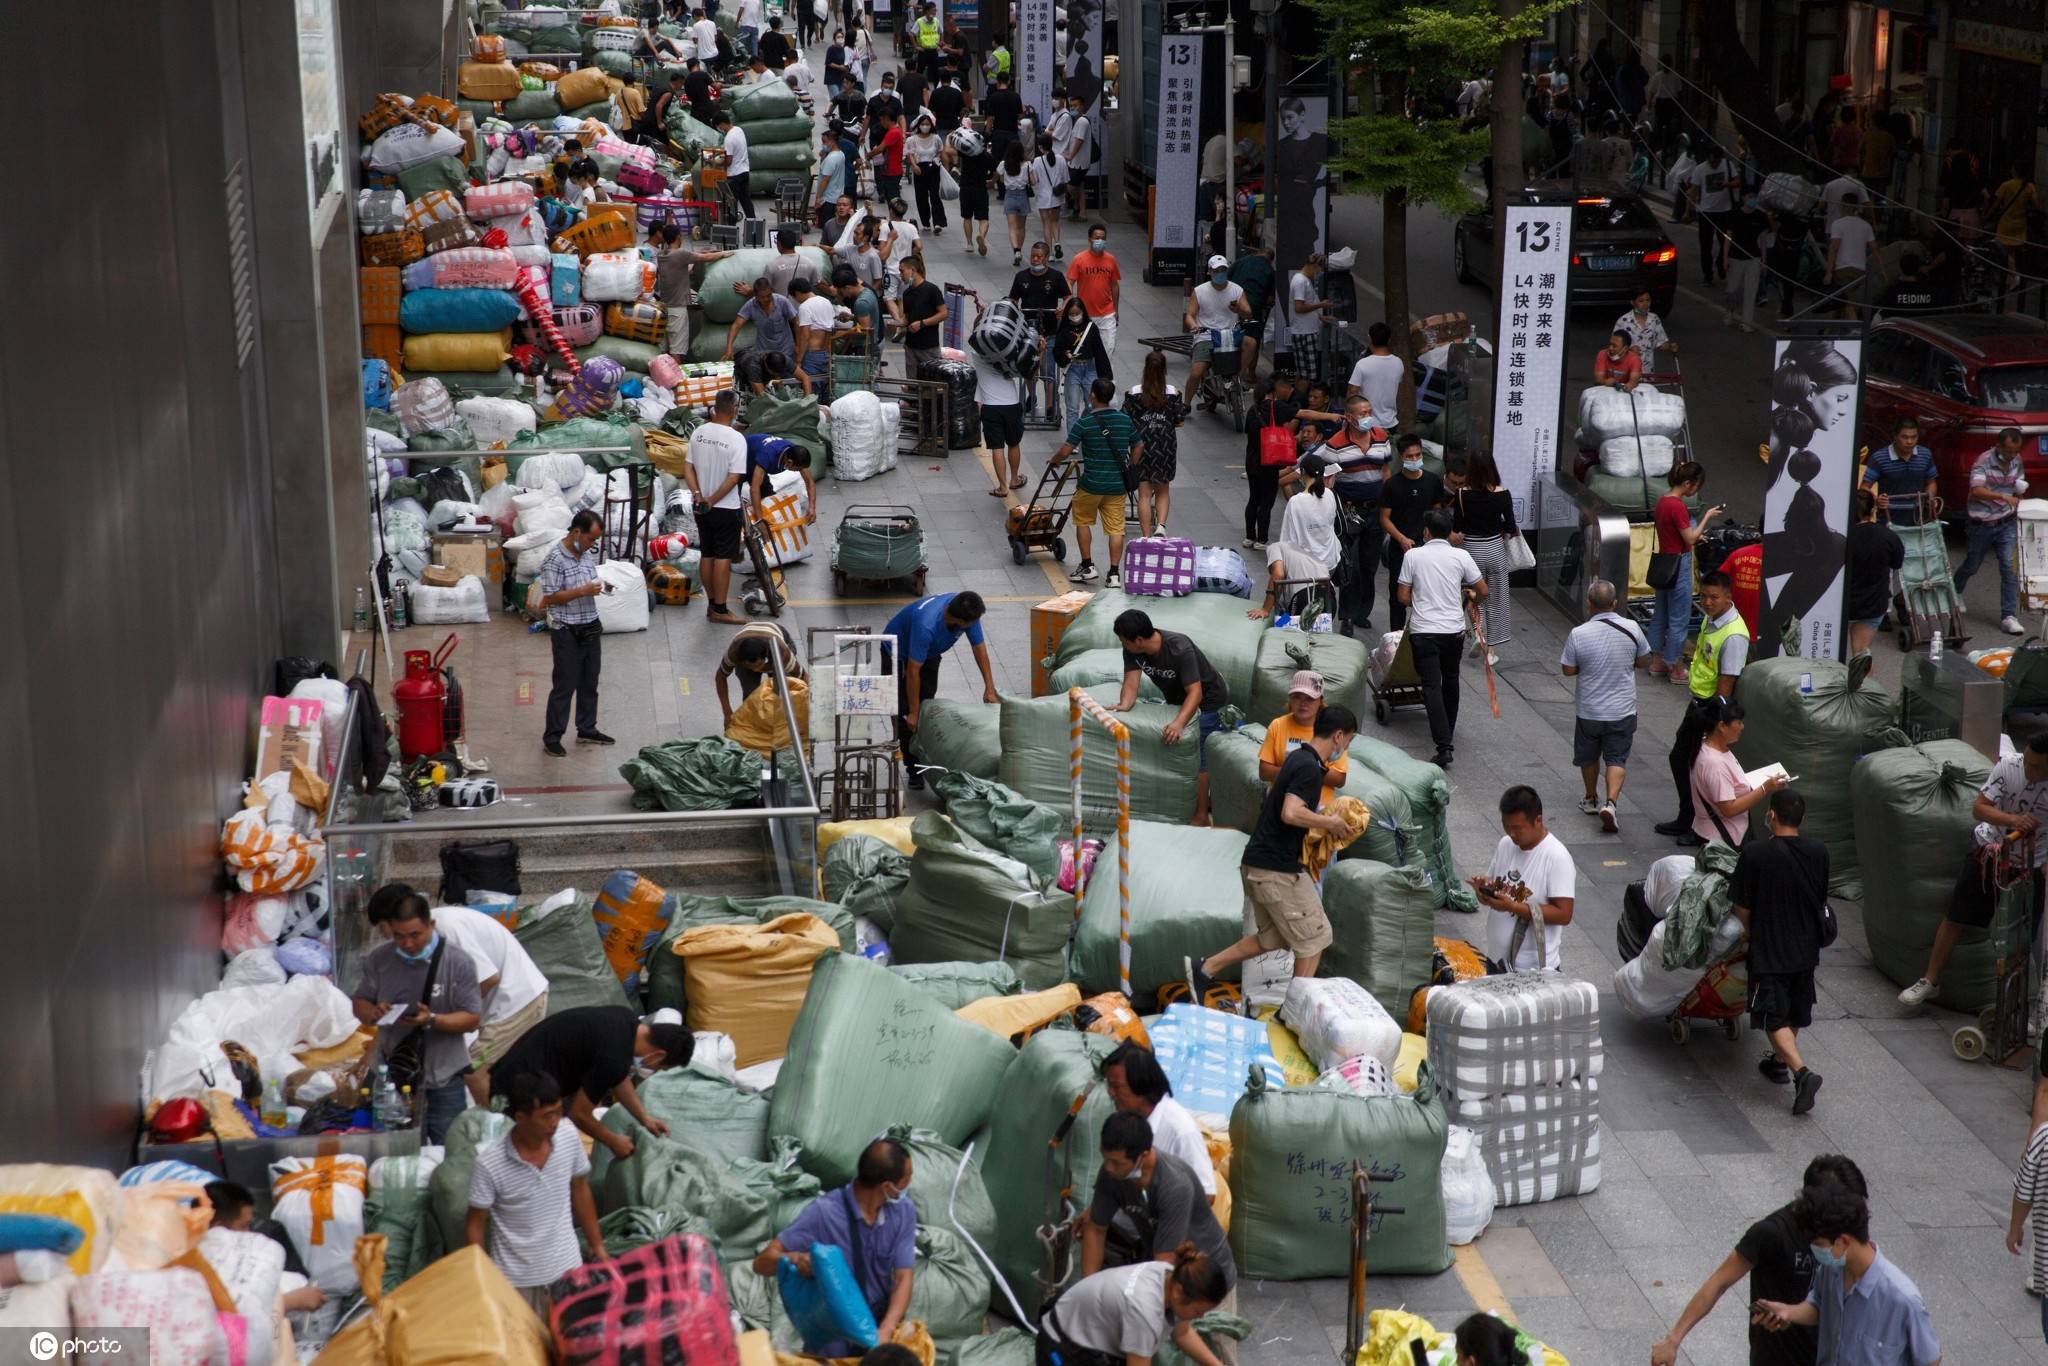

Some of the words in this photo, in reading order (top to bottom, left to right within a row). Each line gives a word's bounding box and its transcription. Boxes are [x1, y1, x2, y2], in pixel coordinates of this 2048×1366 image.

[1168, 45, 1190, 64] 13
[1165, 78, 1178, 153] 聚焦潮流动态
[1180, 78, 1193, 153] 引爆时尚热潮
[1516, 222, 1551, 252] 13
[1536, 273, 1555, 348] 潮势来袭
[1897, 294, 1931, 304] FEIDING
[1506, 275, 1534, 426] L4快时尚连锁基地
